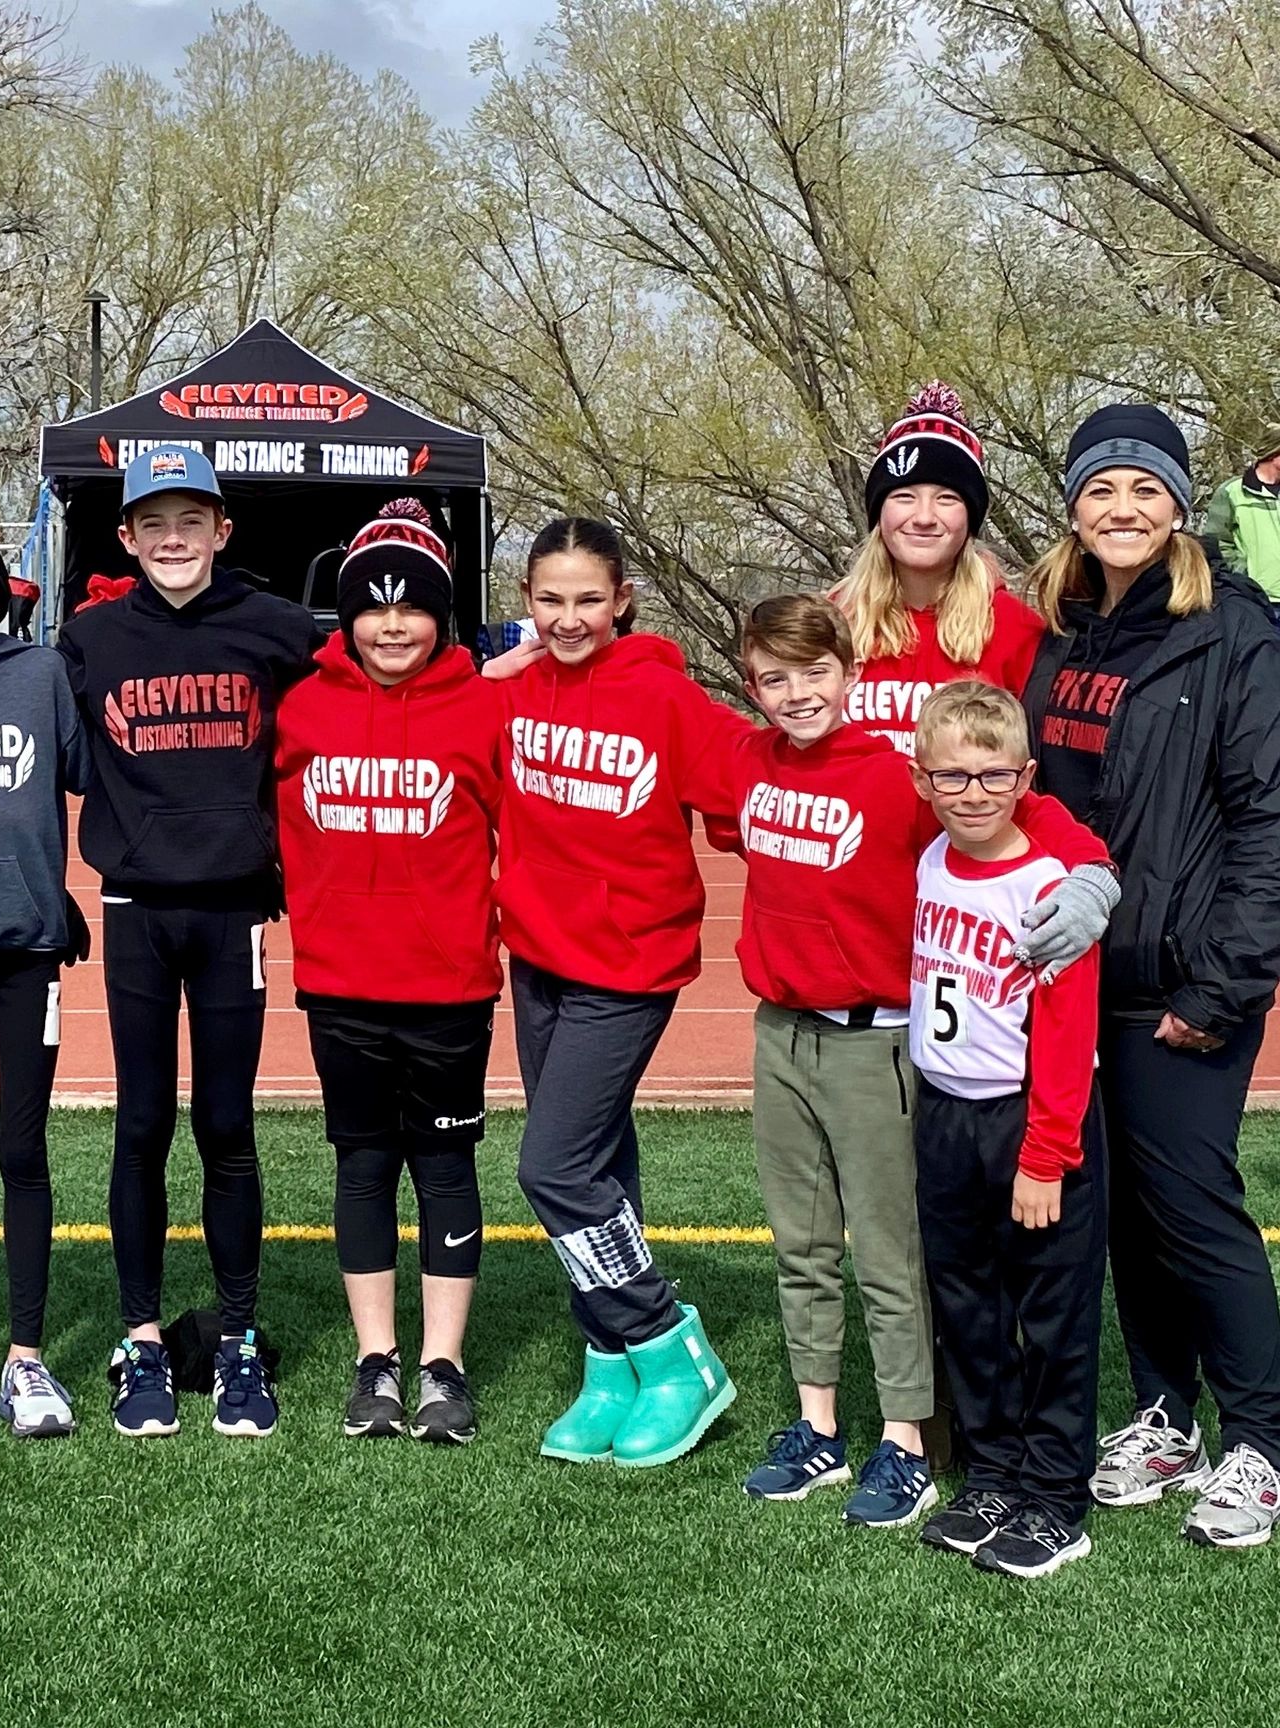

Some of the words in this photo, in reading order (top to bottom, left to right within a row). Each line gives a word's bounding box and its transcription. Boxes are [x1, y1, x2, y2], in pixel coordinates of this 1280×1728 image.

[181, 383, 349, 405] ELEVATED
[195, 406, 264, 420] DISTANCE
[265, 406, 333, 421] TRAINING
[118, 439, 203, 469] ELED
[215, 440, 305, 473] DISTANCE
[320, 443, 409, 476] TRAINING
[121, 673, 251, 718] ELEVATED
[849, 680, 946, 723] ELEVA
[135, 722, 189, 752] DISTANCE
[190, 721, 243, 749] TRAINING
[511, 716, 644, 778] ELEVATED
[312, 755, 440, 799] ELEVATED
[567, 777, 623, 814] TRAINING
[320, 804, 367, 832] DISTANCE
[782, 835, 830, 867] TRAINING
[934, 976, 958, 1042] 5
